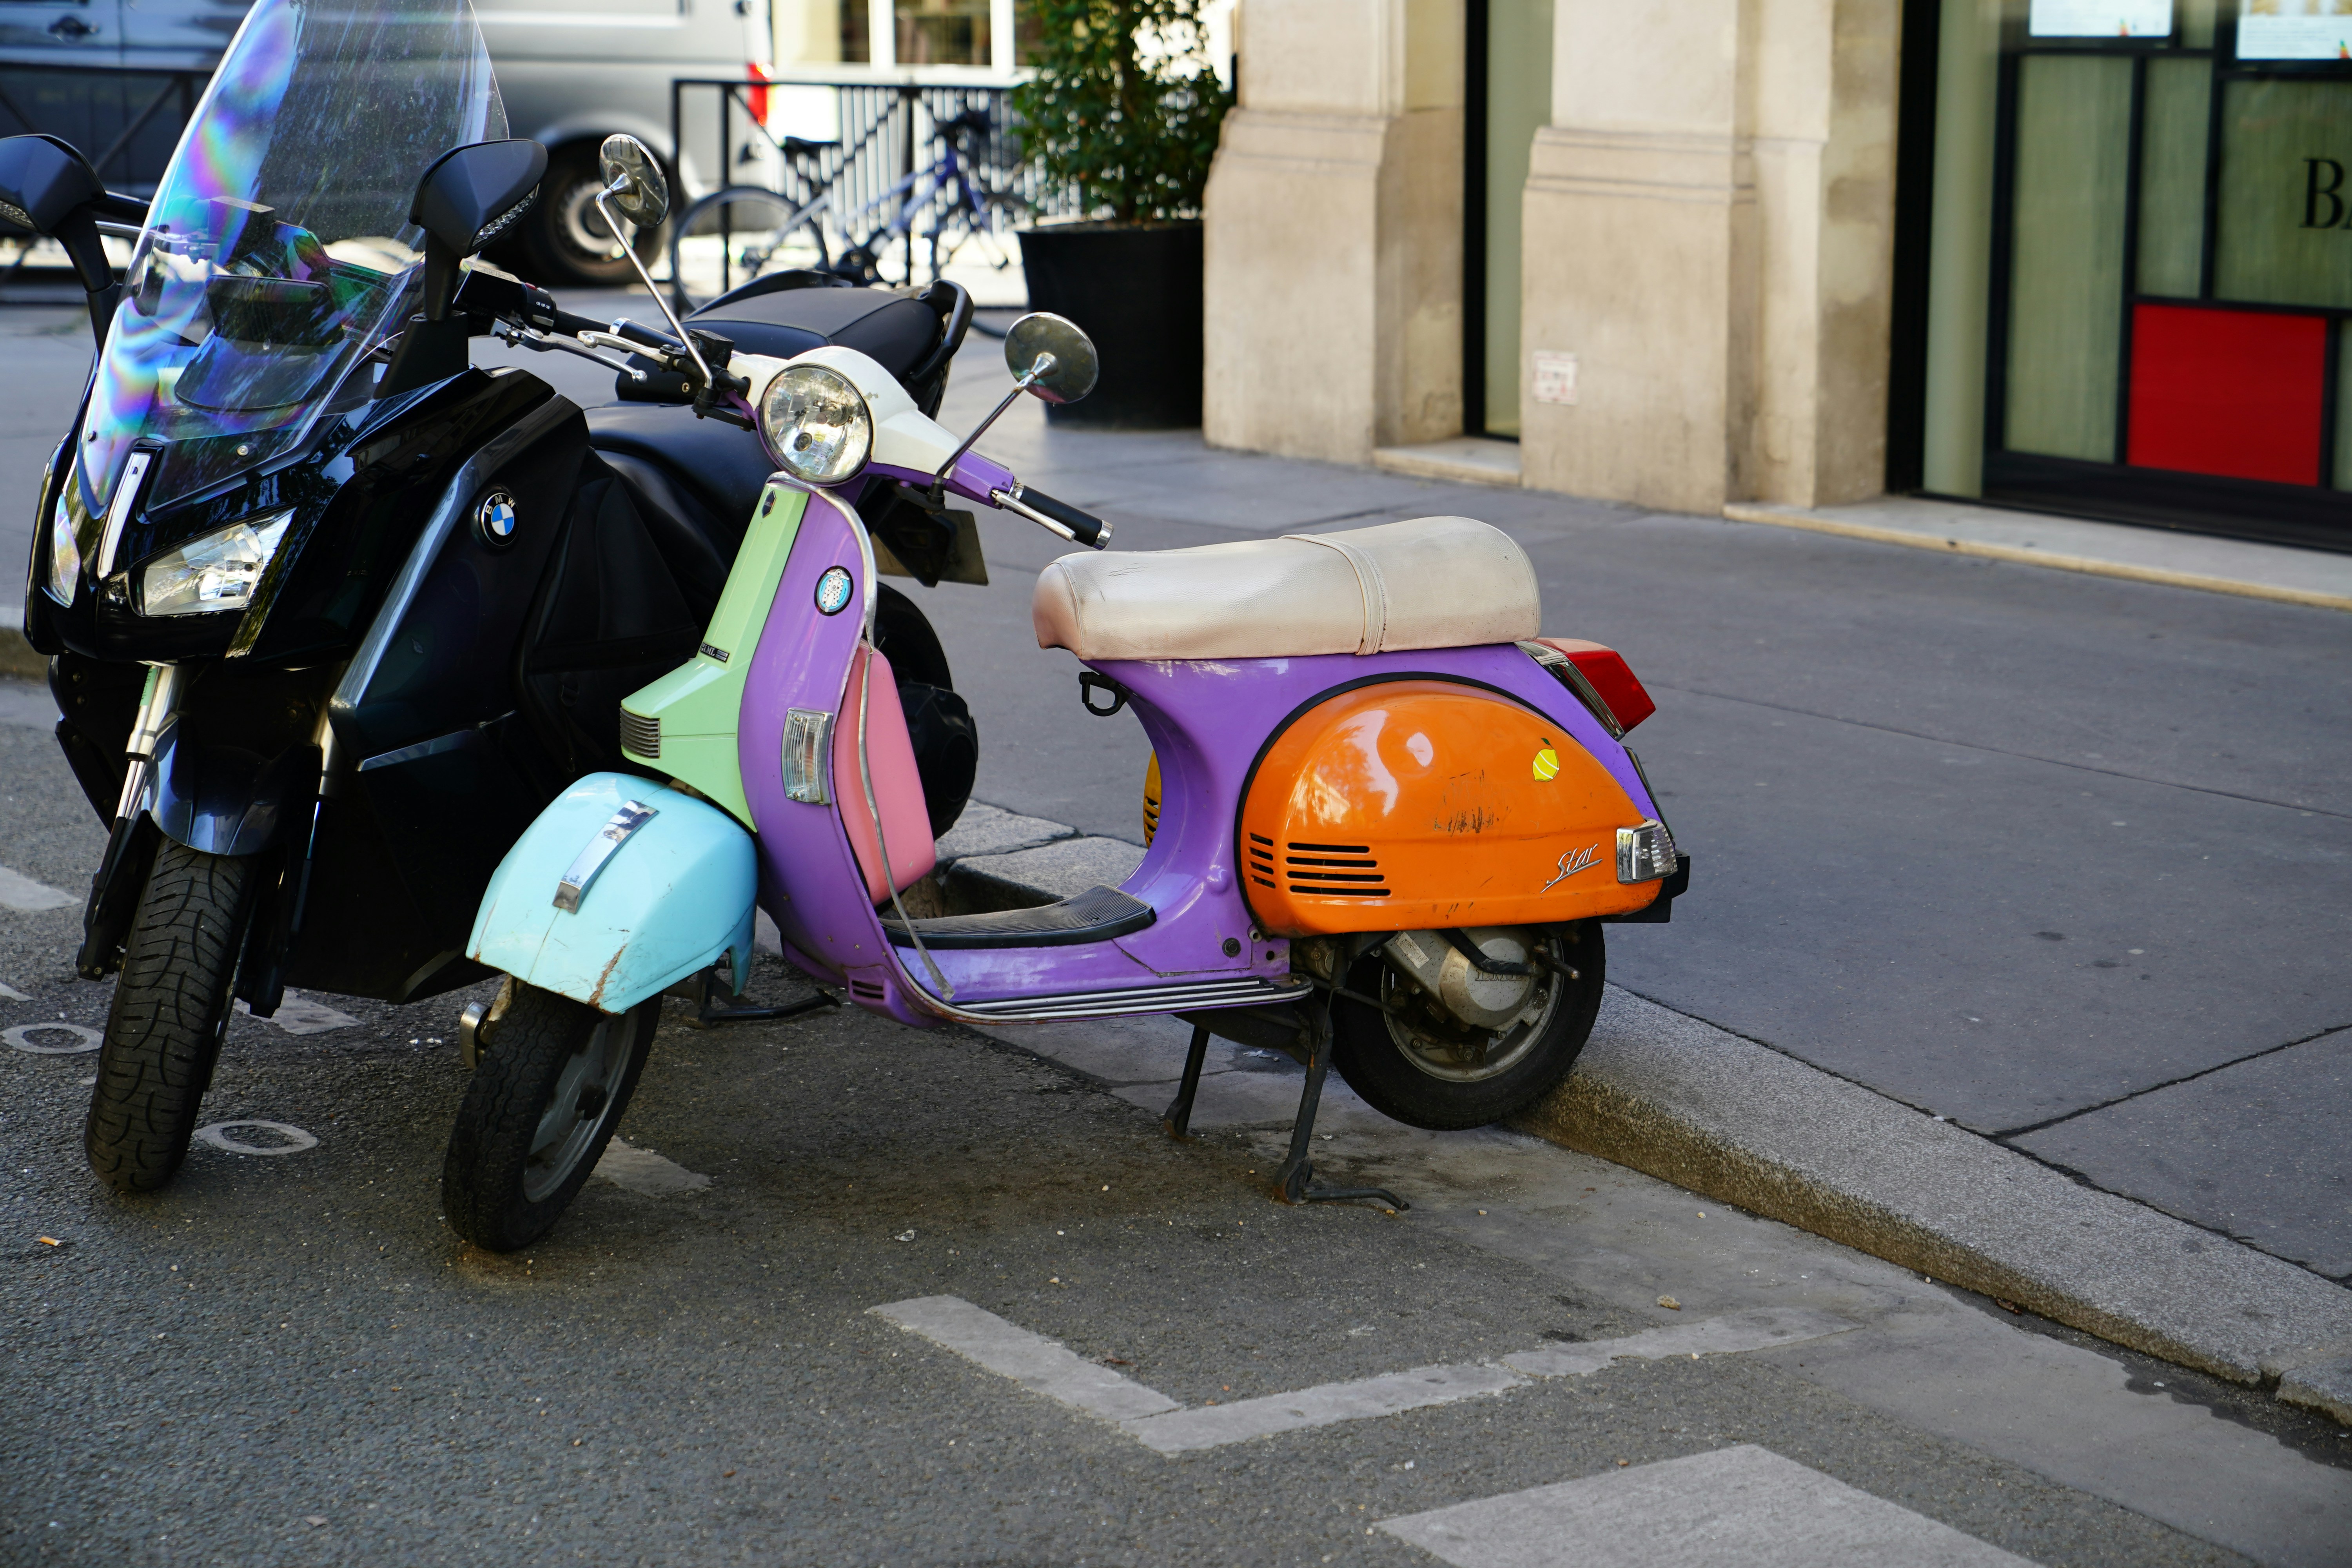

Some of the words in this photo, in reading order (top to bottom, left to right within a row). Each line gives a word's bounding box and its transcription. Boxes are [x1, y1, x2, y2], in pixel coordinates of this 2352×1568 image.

[2298, 158, 2352, 230] B
[485, 495, 515, 515] BMW
[703, 644, 715, 657] LML
[1545, 843, 1599, 885] Star
